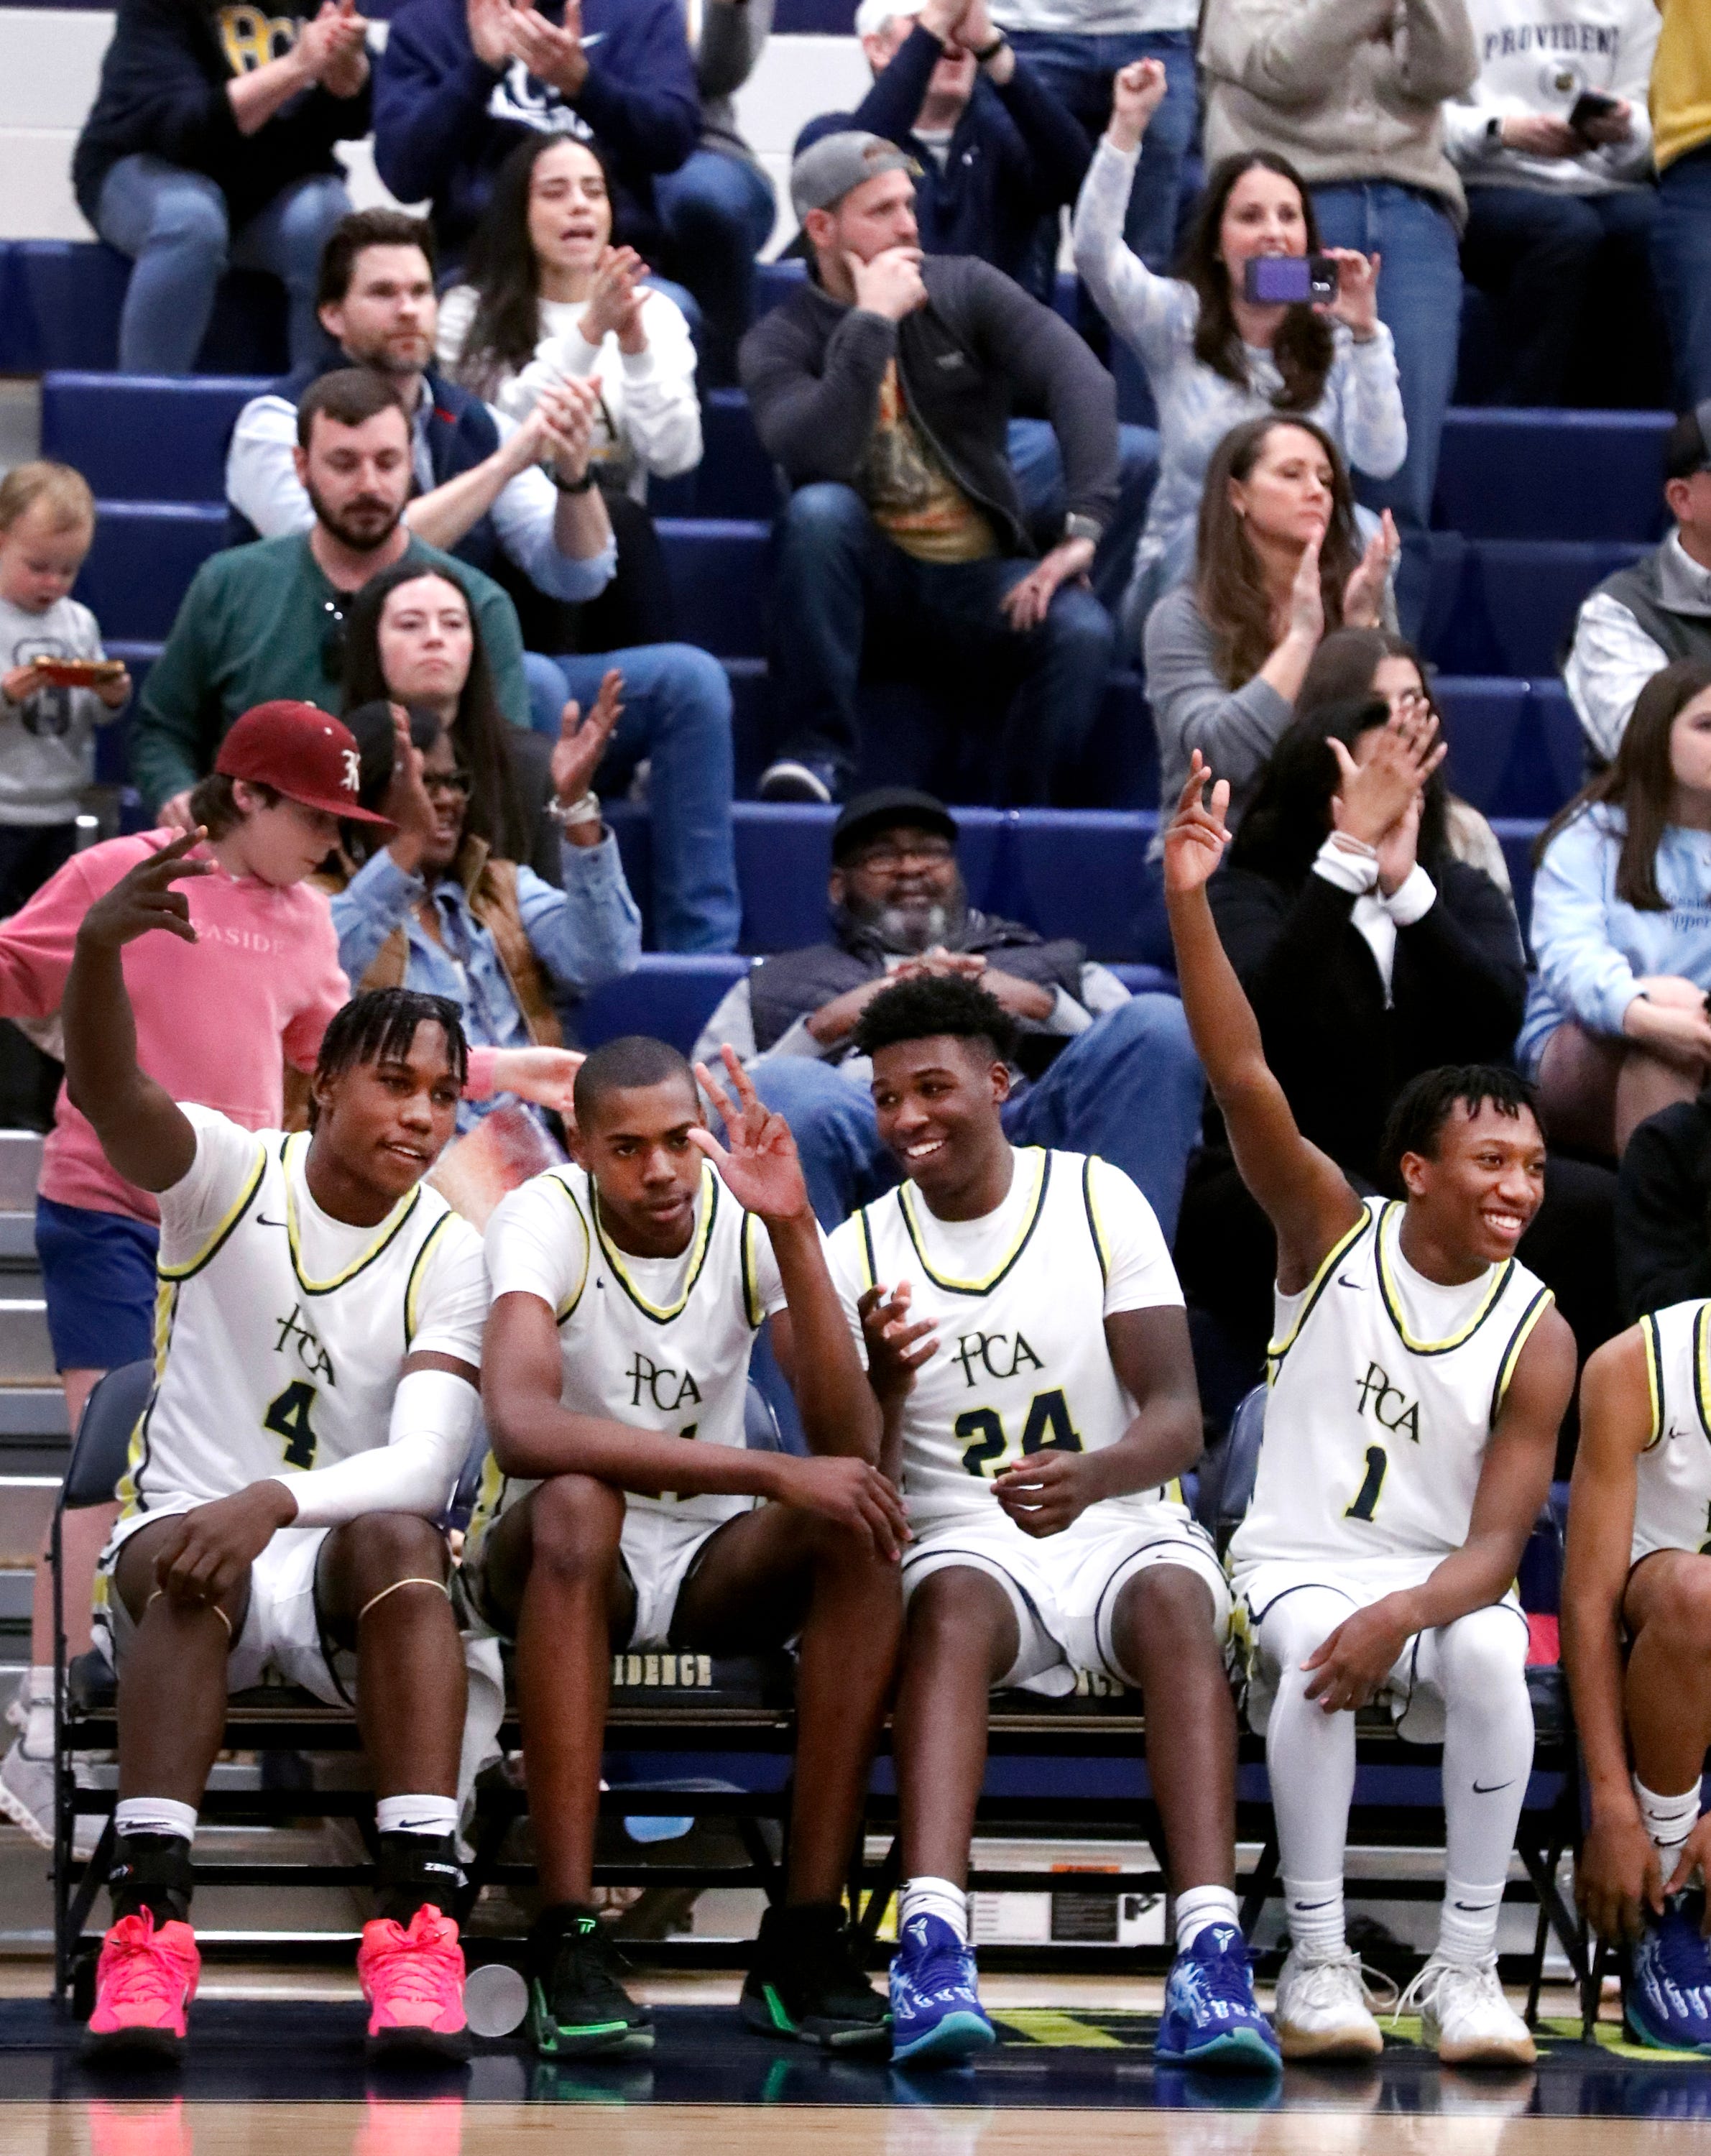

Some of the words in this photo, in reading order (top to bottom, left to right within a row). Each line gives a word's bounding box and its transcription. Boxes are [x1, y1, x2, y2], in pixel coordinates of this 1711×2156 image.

[625, 1351, 703, 1411] PCA
[951, 1331, 1046, 1388] PCA
[264, 1378, 318, 1471] 4
[954, 1385, 1086, 1478] 24
[1355, 1361, 1419, 1444] PCA
[1342, 1443, 1388, 1523] 1
